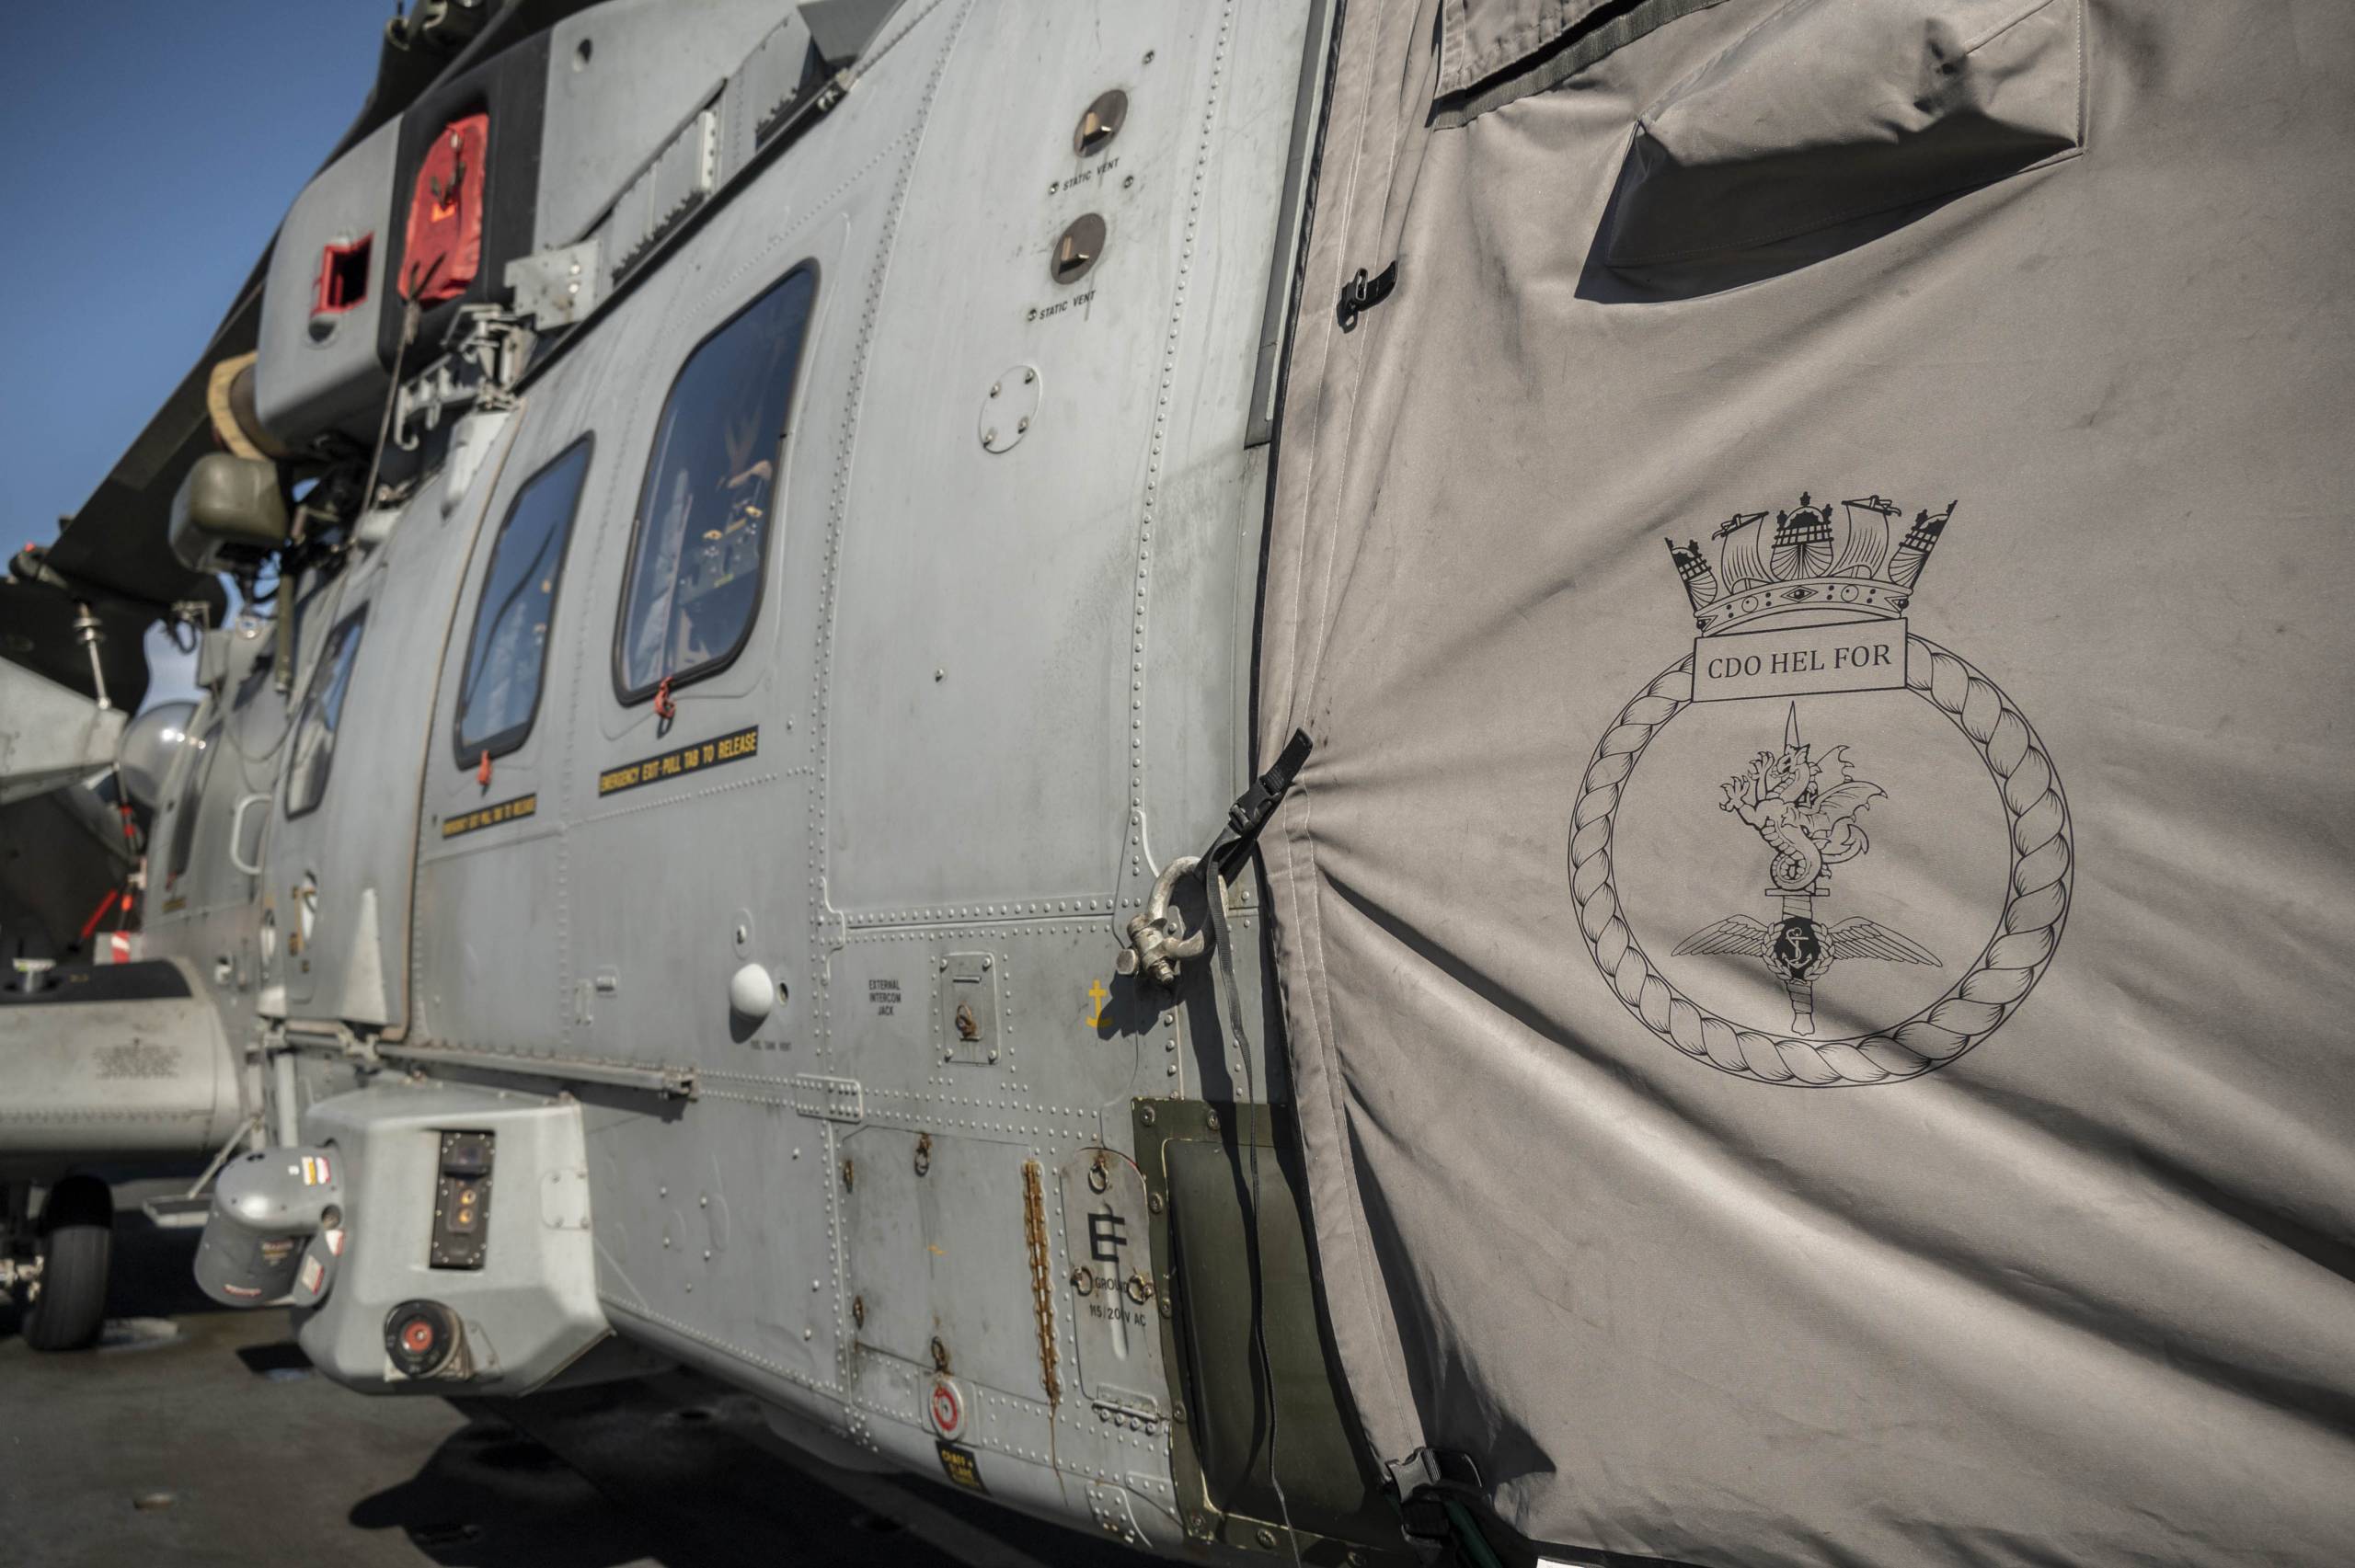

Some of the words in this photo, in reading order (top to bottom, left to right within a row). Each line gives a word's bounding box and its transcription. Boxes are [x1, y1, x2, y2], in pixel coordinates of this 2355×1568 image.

[1063, 170, 1092, 190] STATIC
[1097, 157, 1120, 176] VENT
[1039, 301, 1068, 320] STATIC
[1073, 290, 1097, 307] VENT
[1708, 655, 1762, 679] CDO
[1770, 649, 1825, 674] HEL
[1833, 644, 1891, 670] FOR
[684, 749, 699, 769] TAB
[703, 744, 715, 764] TO
[718, 732, 757, 760] RELEASE
[868, 979, 901, 990] EXTERNAL
[869, 992, 902, 1003] INTERCOM
[1087, 1213, 1127, 1262] E
[1134, 1312, 1146, 1326] AC
